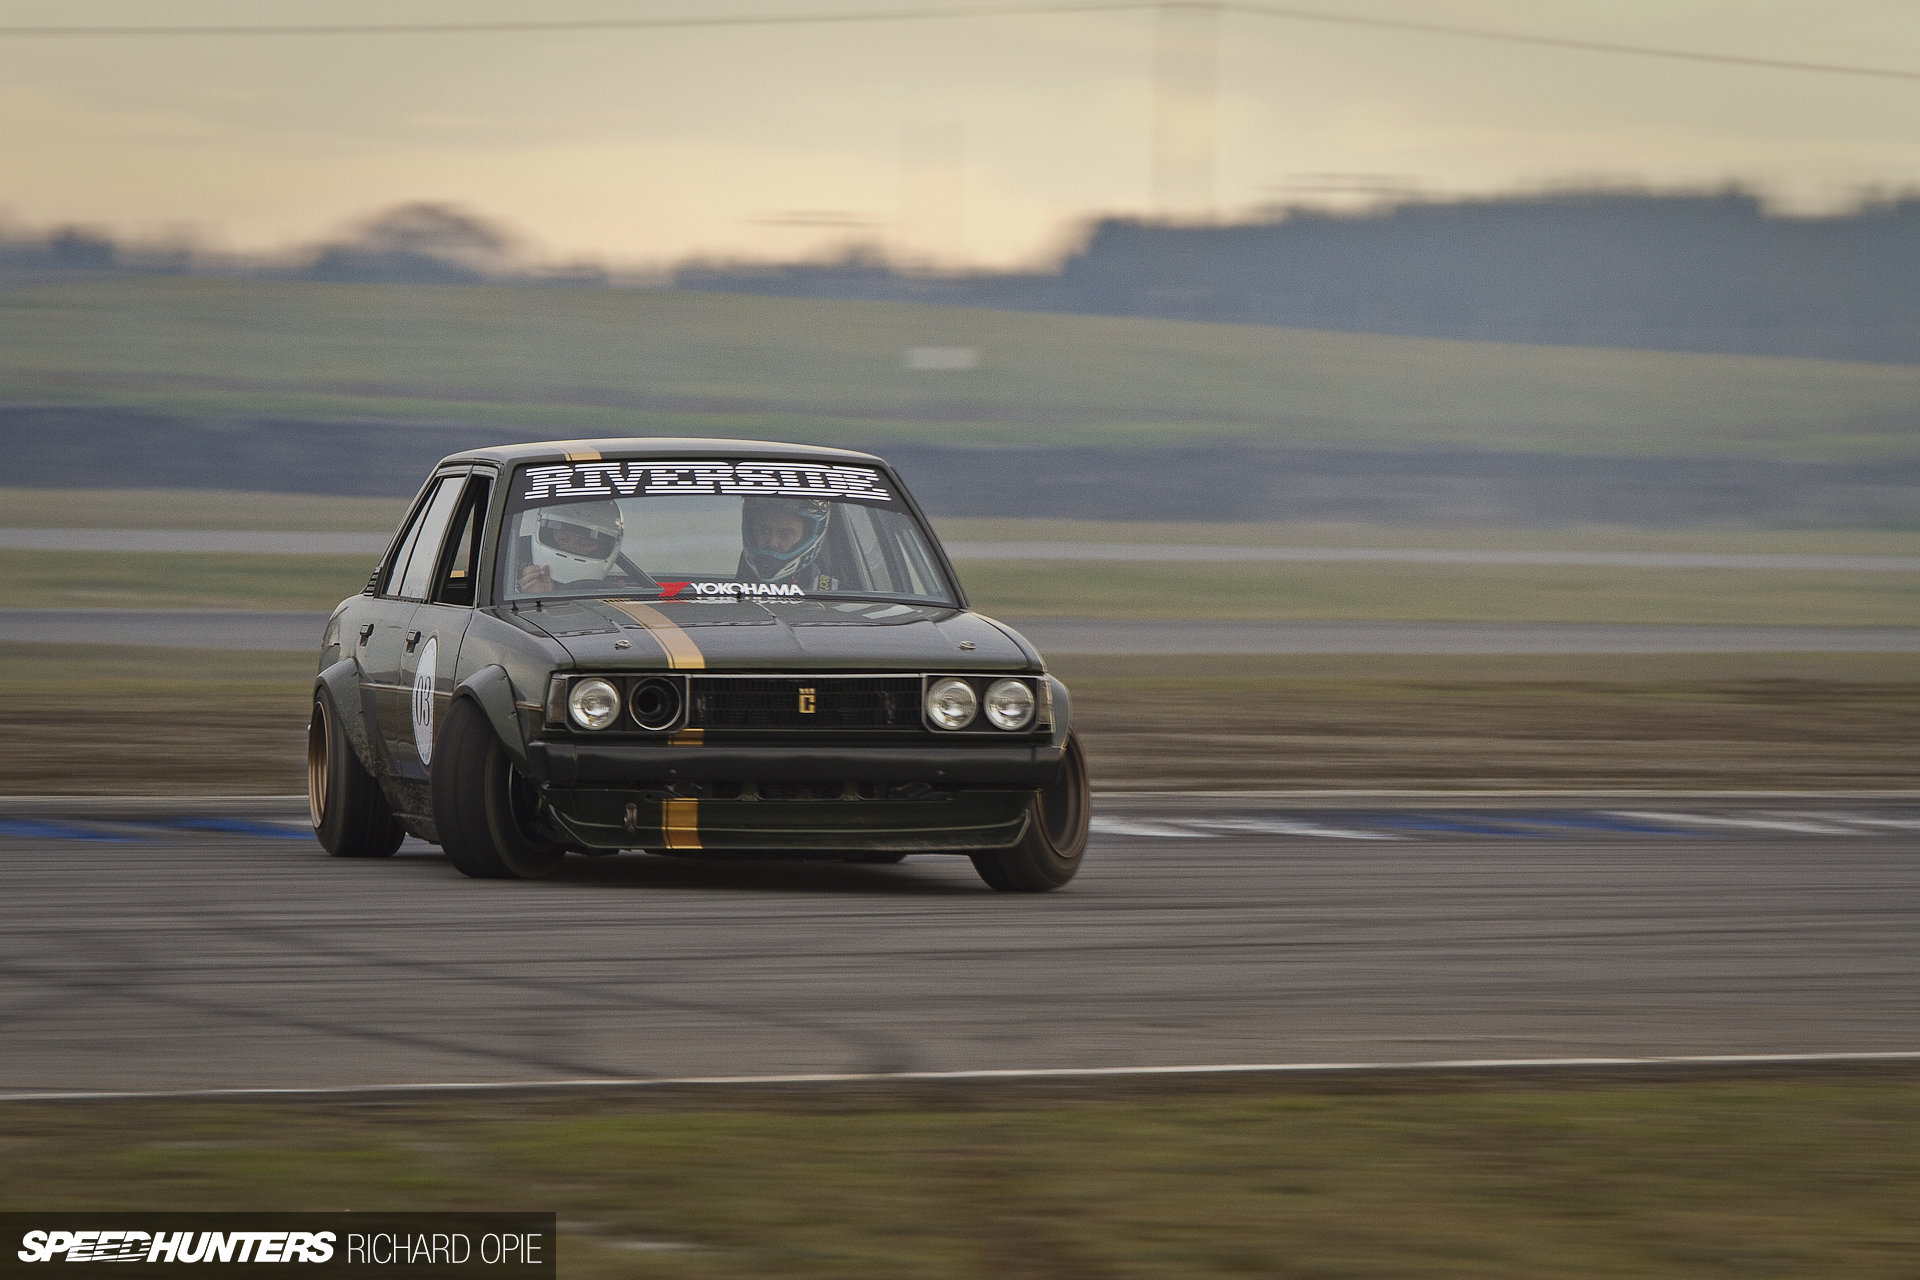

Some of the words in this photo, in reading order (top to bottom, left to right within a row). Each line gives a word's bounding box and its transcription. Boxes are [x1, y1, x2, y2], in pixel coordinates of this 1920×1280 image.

[524, 461, 893, 500] RIVERSIDE
[690, 582, 806, 597] YOKOHAMA
[415, 675, 432, 727] 03
